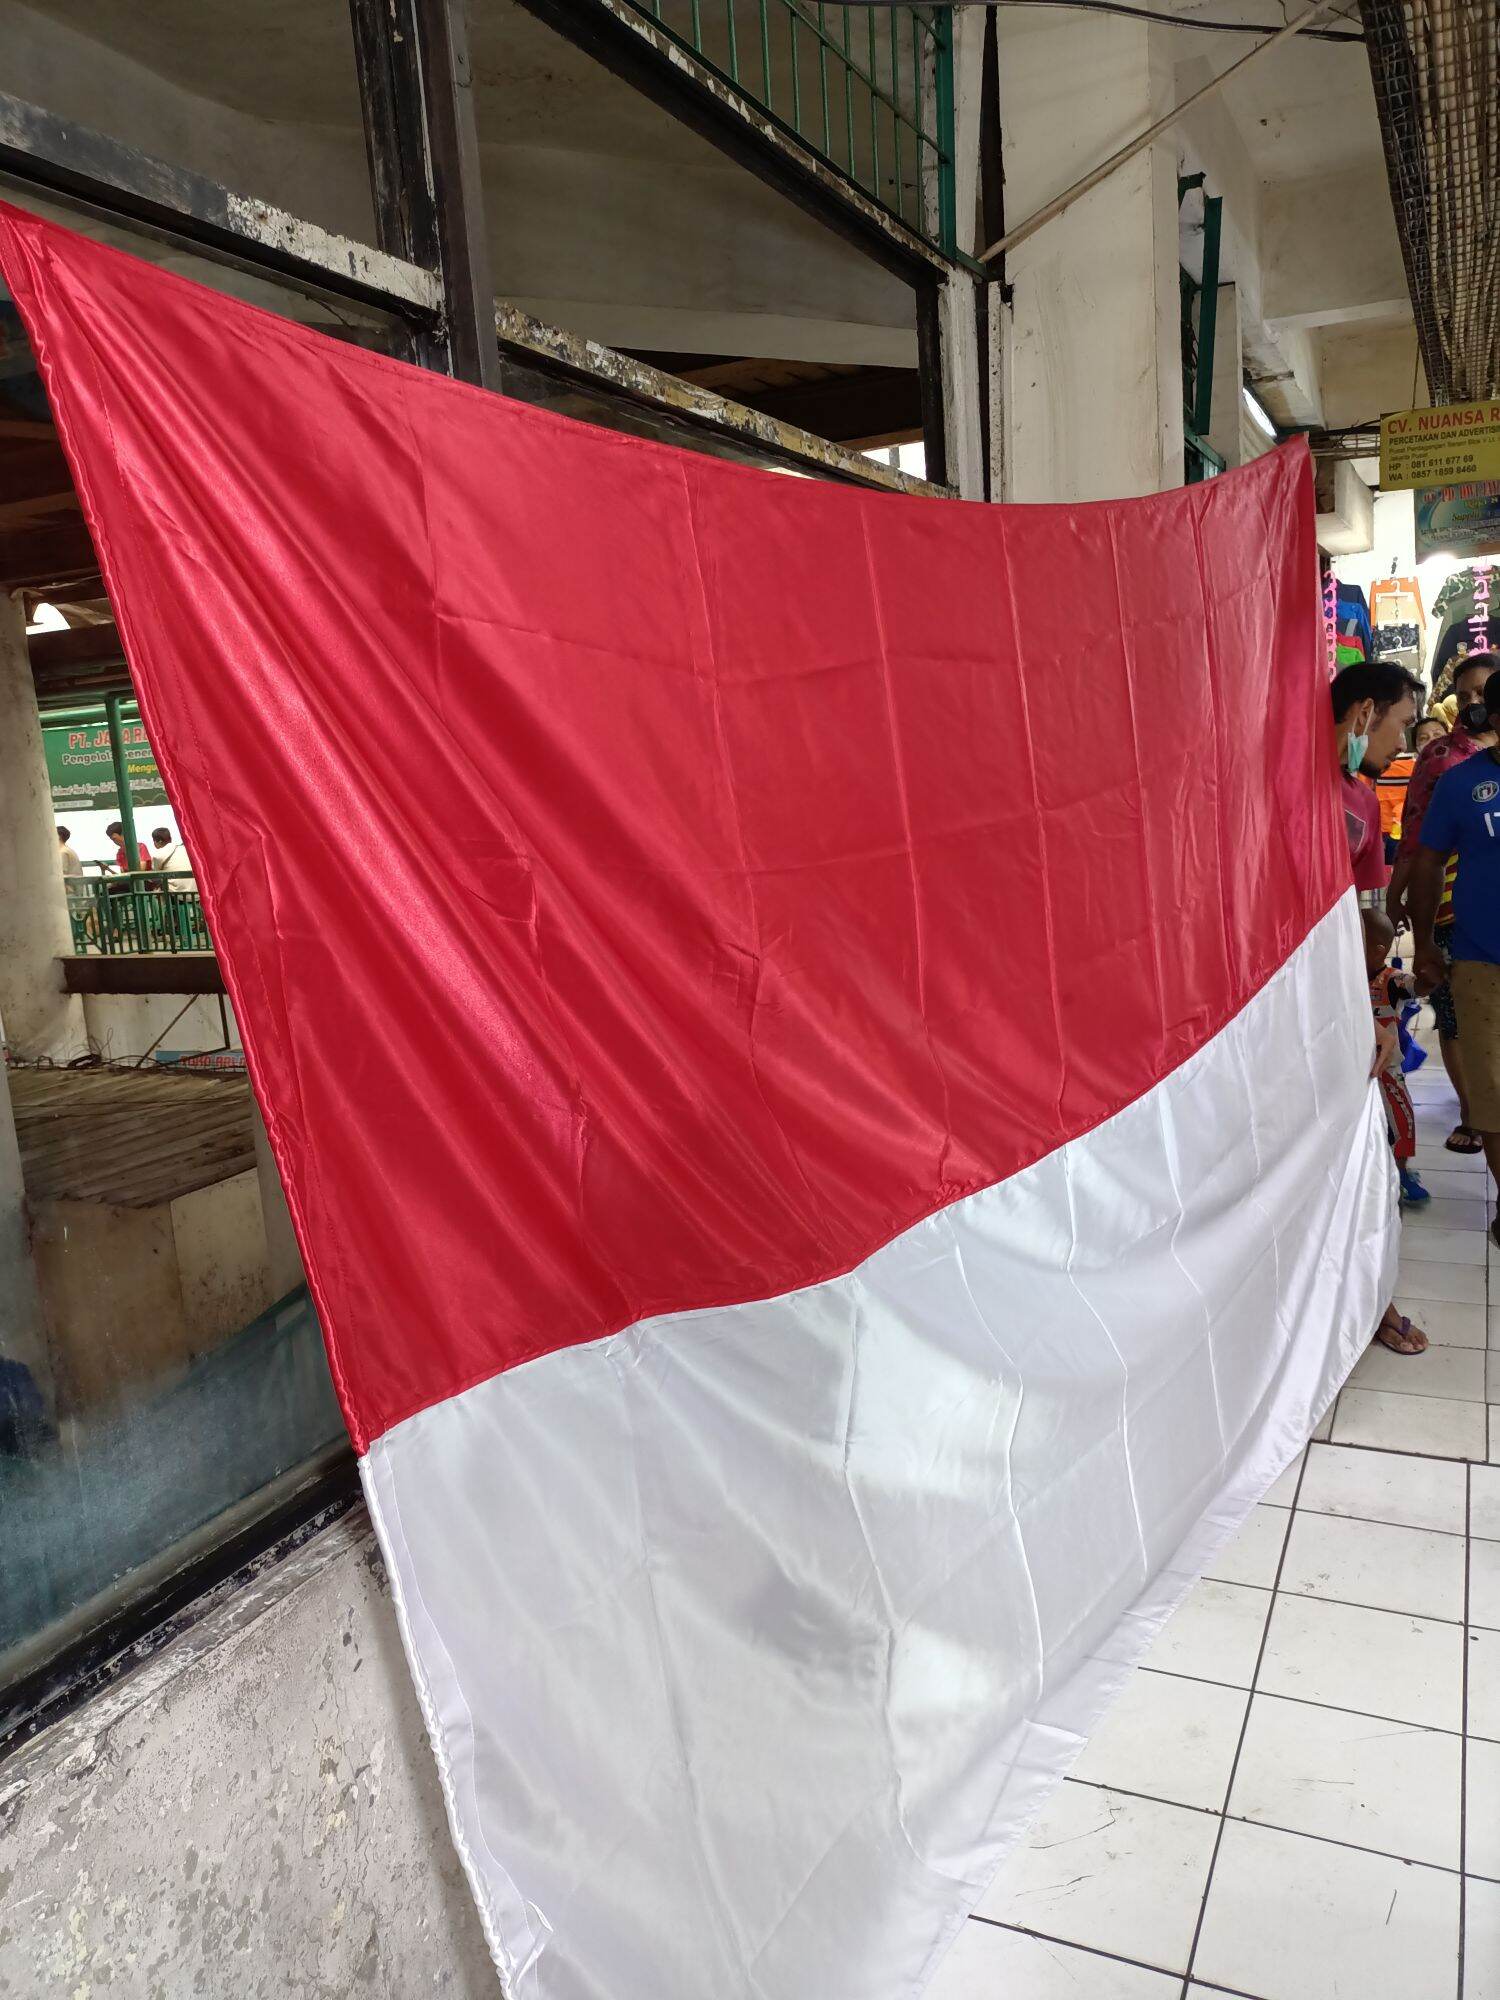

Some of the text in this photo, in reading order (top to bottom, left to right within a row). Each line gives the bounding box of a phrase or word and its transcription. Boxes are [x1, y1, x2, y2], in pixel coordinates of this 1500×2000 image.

[1388, 418, 1412, 435] CV.
[1418, 410, 1485, 431] NUANSA
[1388, 434, 1439, 446] PERCETAKAN
[1440, 431, 1457, 440] DAN
[1388, 463, 1402, 472] HP
[1411, 460, 1426, 470] 081
[1388, 472, 1403, 482] WA
[1411, 469, 1431, 480] 0857
[69, 731, 92, 749] PT.
[94, 728, 131, 747] JAA
[62, 750, 113, 765] Pengelol
